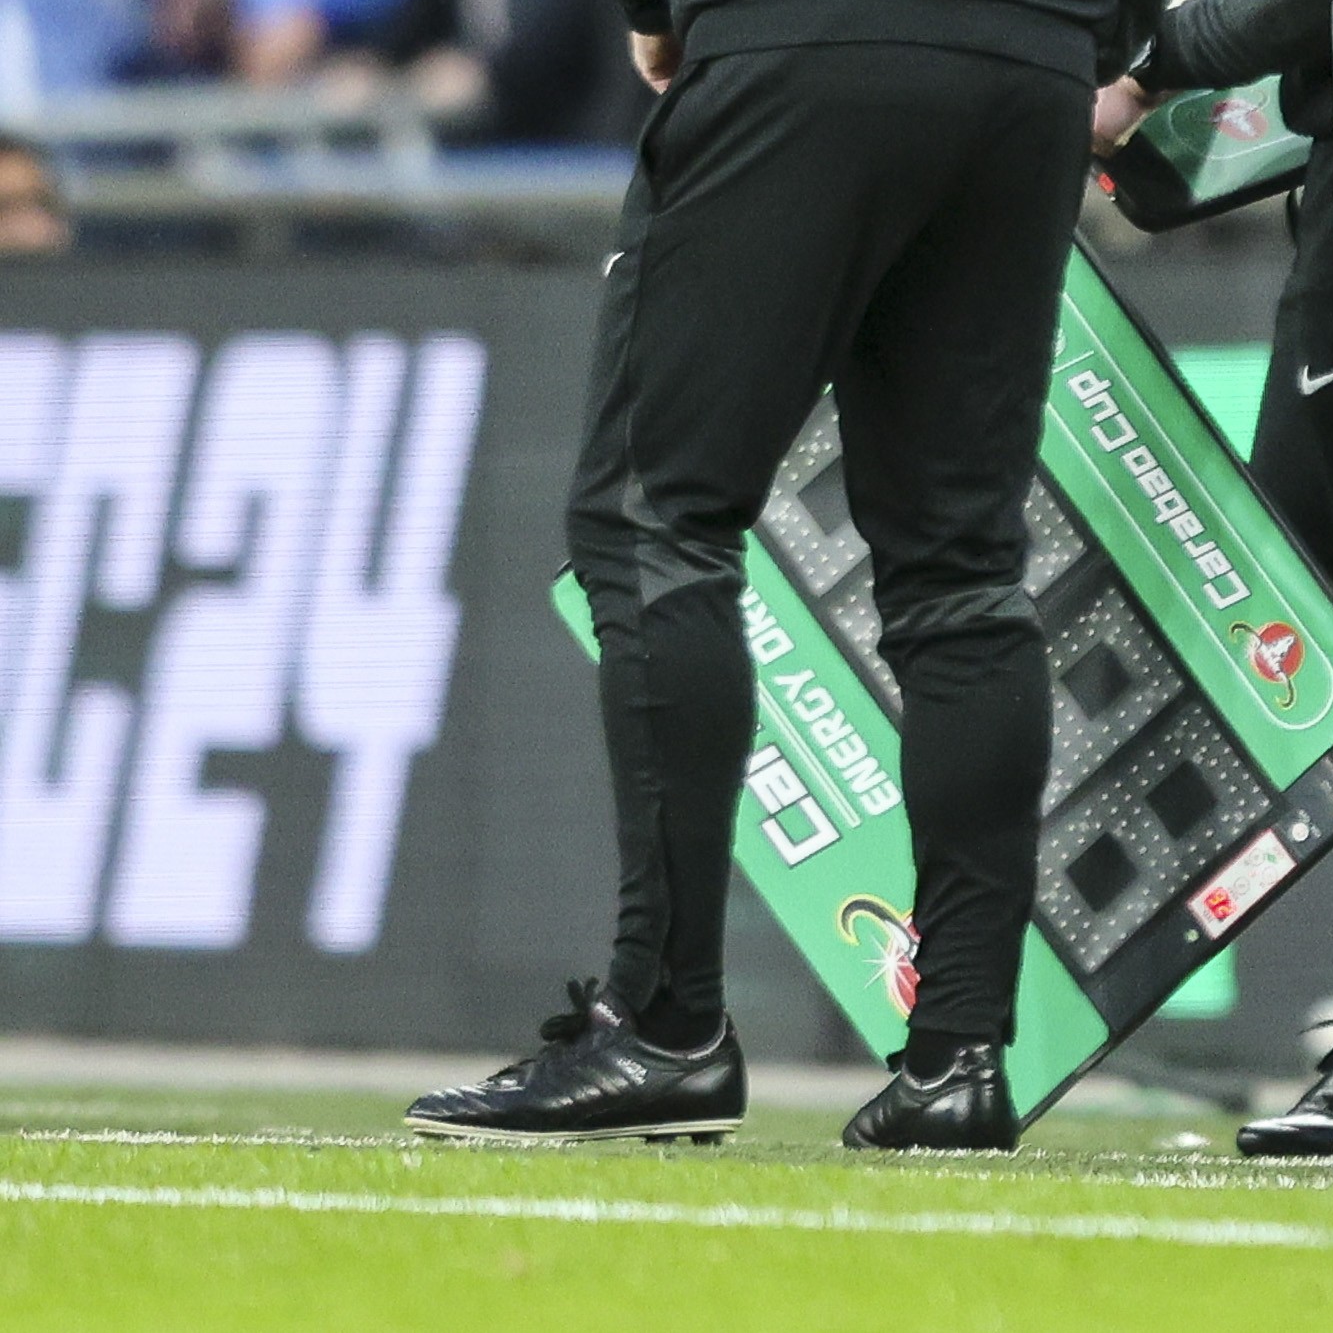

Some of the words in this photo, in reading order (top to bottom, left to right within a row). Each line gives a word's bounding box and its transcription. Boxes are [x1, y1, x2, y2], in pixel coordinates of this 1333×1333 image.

[1067, 369, 1139, 454] Cup
[1121, 444, 1251, 611] Carabao
[773, 667, 902, 817] ENERGY
